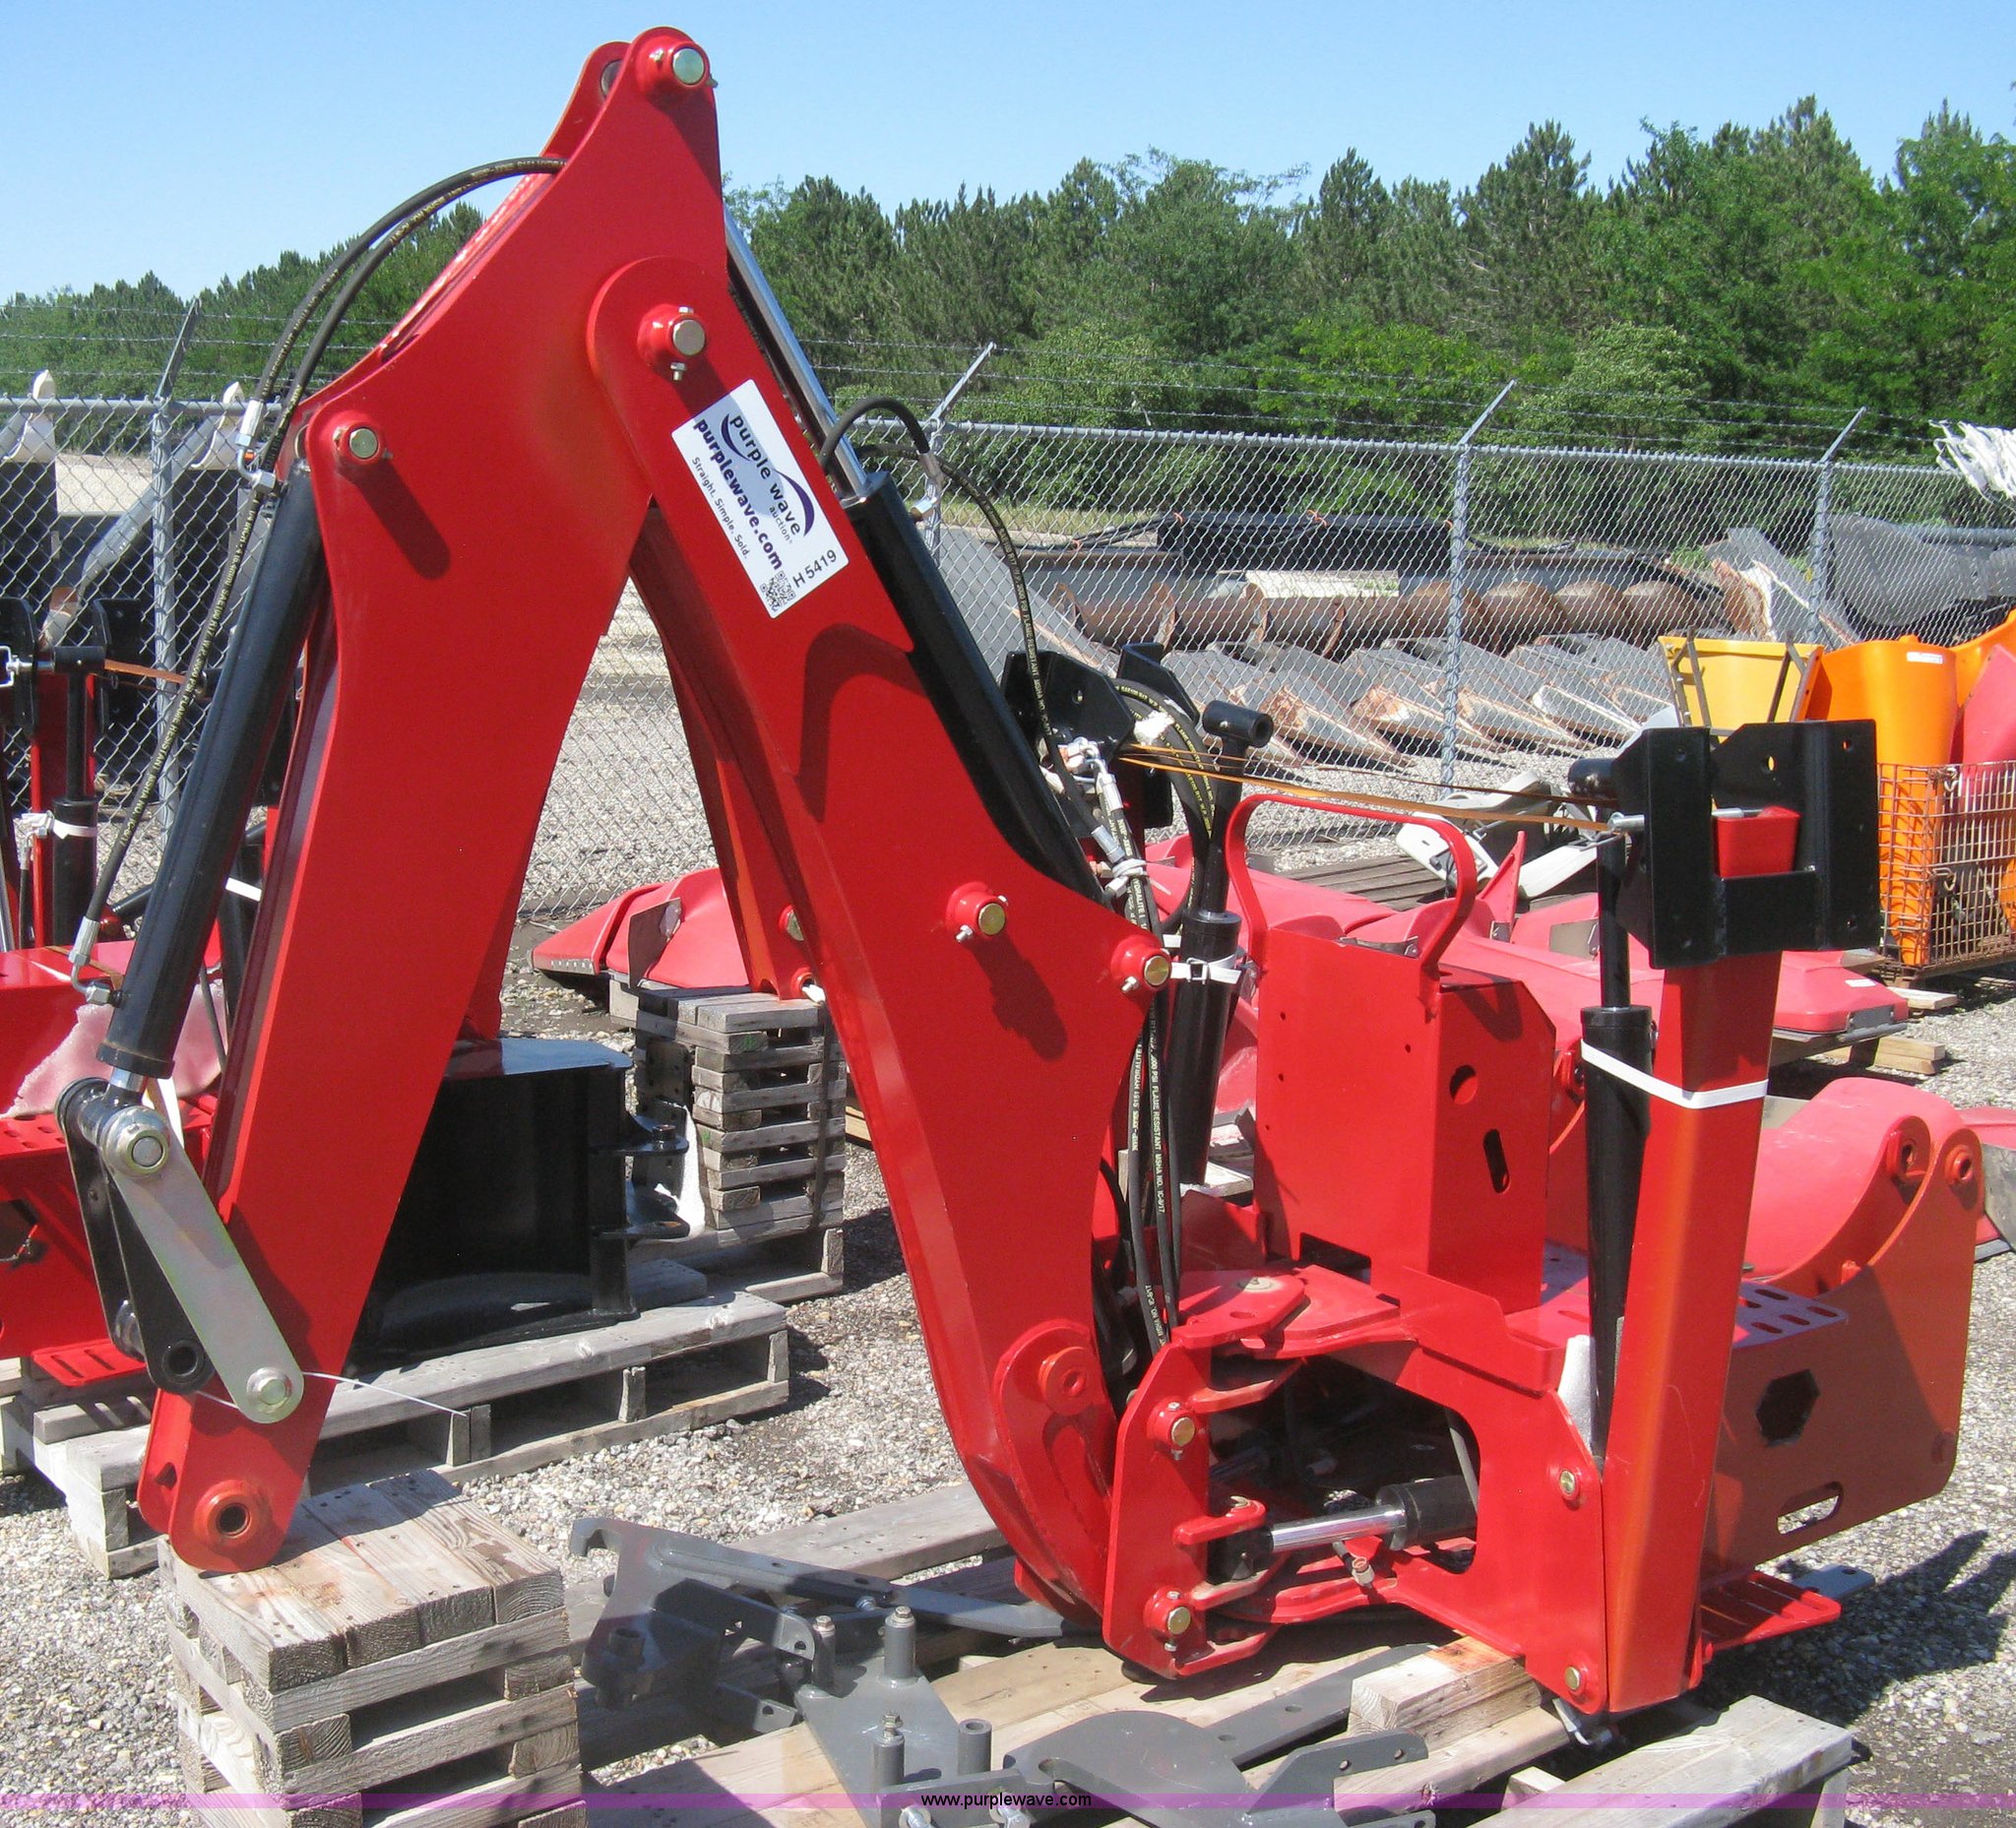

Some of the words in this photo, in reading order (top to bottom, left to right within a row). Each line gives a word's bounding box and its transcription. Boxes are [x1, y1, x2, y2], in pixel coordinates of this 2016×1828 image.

[693, 418, 783, 571] purplewave.com
[729, 414, 772, 480] purple
[769, 483, 801, 536] wave
[692, 457, 716, 498] Straight.
[714, 497, 734, 535] Simple.
[733, 534, 749, 559] Sold.
[805, 549, 837, 580] 5419
[172, 695, 190, 725] FLAME
[153, 724, 178, 770] RESISTANT
[1153, 1110, 1162, 1151] RESISTANT
